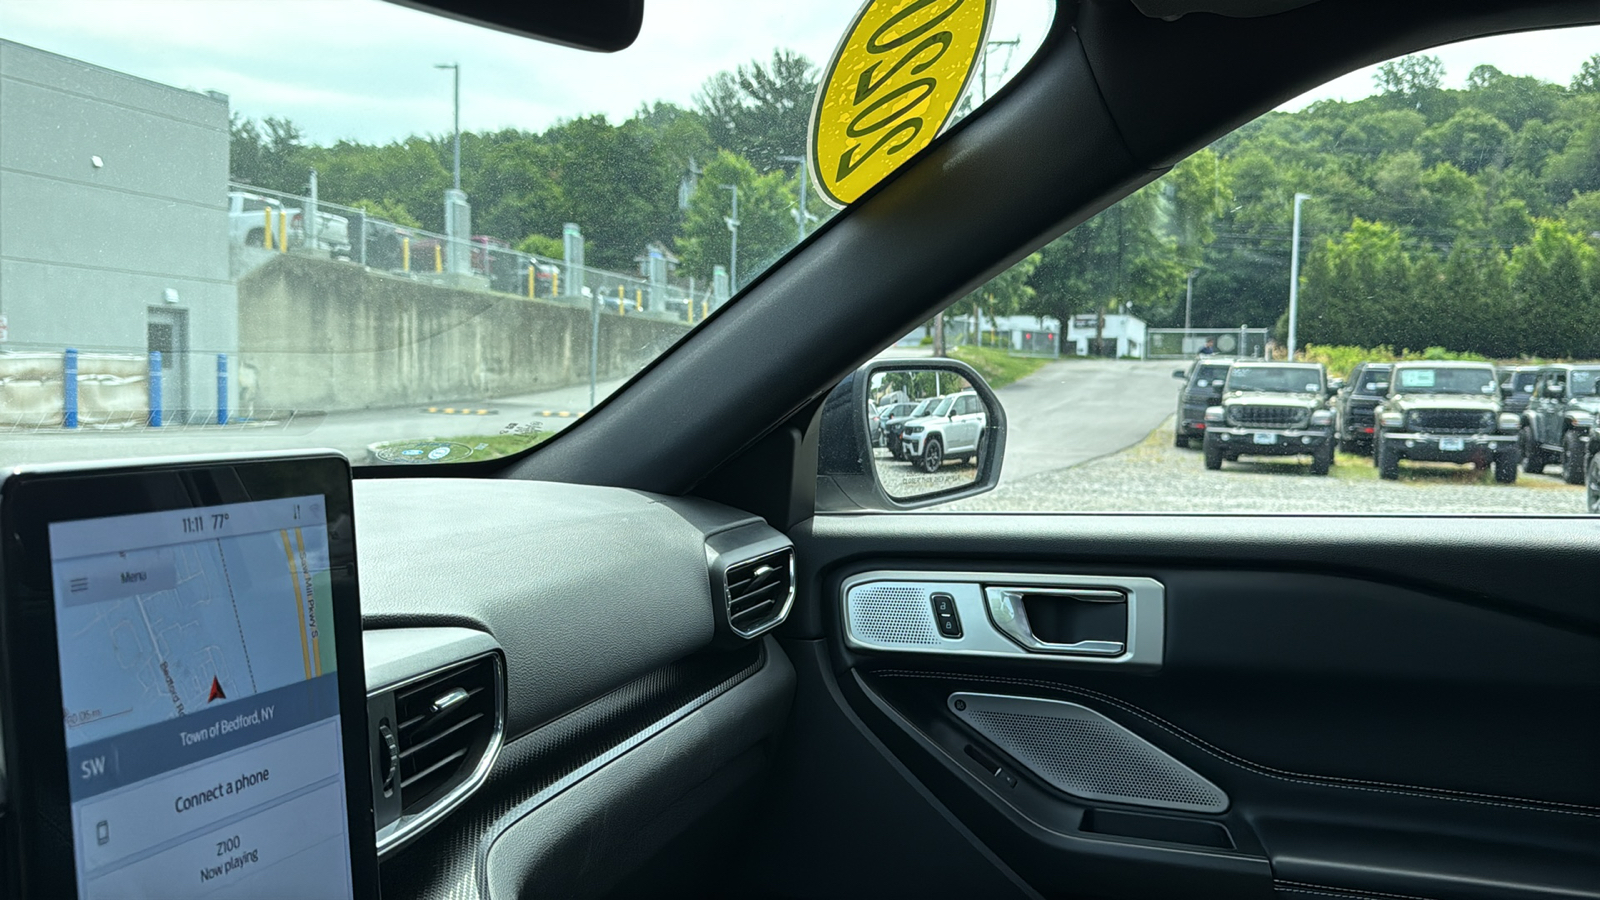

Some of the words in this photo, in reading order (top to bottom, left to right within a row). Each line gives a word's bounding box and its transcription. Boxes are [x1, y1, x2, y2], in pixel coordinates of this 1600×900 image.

[182, 515, 204, 533] 11:11
[211, 512, 230, 530] 77°
[120, 571, 148, 584] Menu
[304, 577, 314, 597] Mill
[307, 598, 317, 628] Pkwy
[310, 629, 319, 639] S
[159, 660, 181, 703] Bedford
[180, 727, 208, 746] Town
[208, 721, 220, 740] of
[221, 713, 261, 735] Bedford,
[261, 705, 276, 723] NY
[81, 756, 106, 779] SW
[174, 783, 224, 813] Connect
[226, 781, 234, 795] a
[235, 768, 270, 795] phone
[215, 835, 241, 857] Z100
[200, 863, 223, 883] Now
[224, 848, 260, 874] playing
